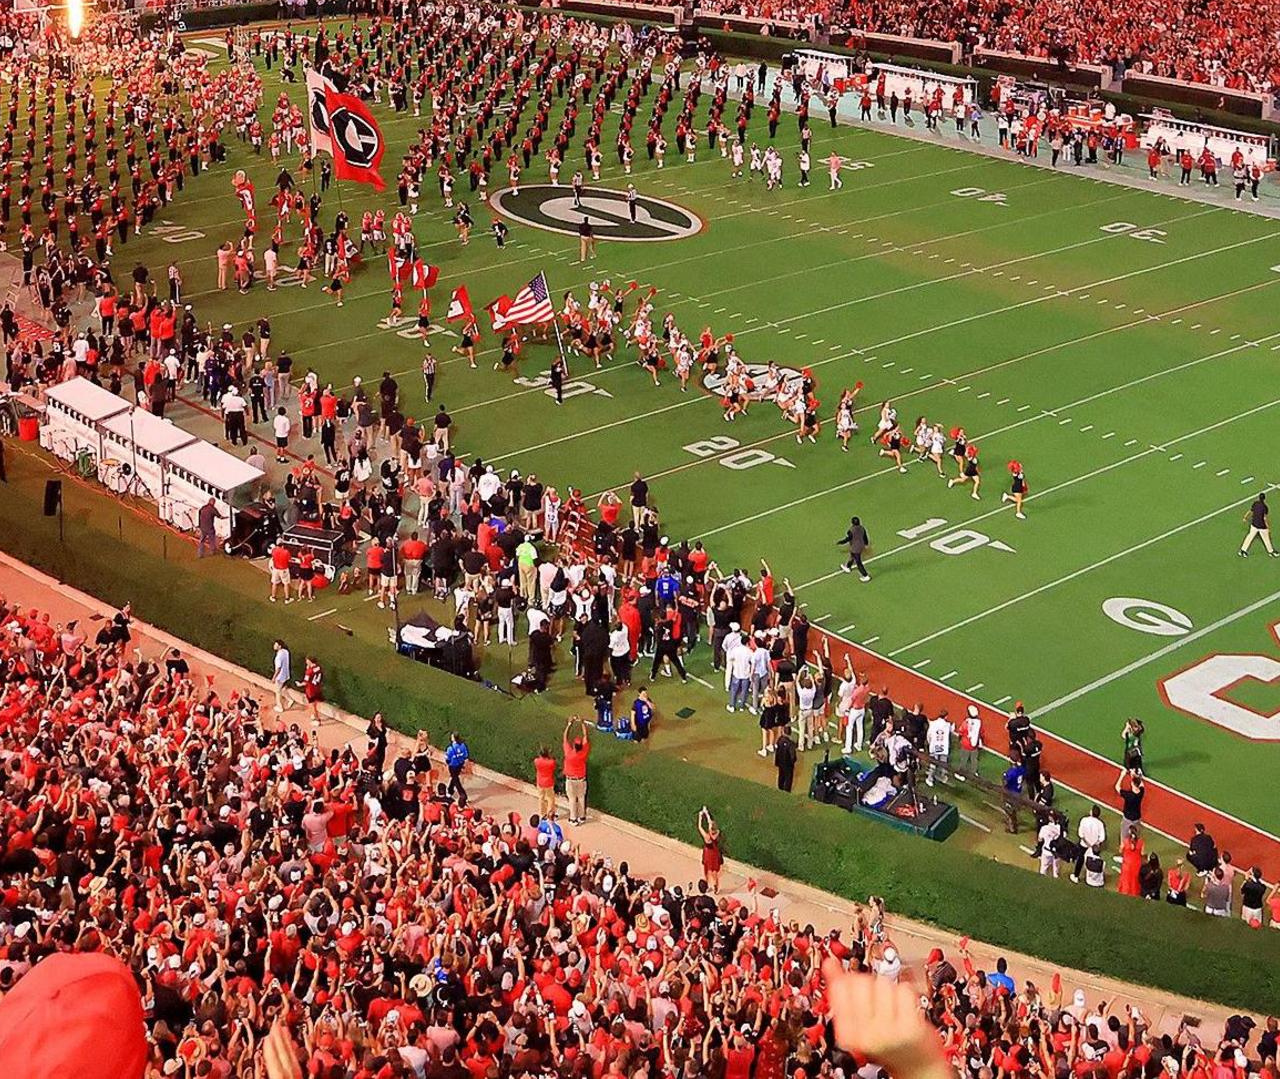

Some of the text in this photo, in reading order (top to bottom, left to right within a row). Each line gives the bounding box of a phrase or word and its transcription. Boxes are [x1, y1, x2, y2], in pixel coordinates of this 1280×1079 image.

[950, 187, 1008, 203] 40
[1100, 221, 1167, 240] 30
[681, 435, 776, 471] 20
[896, 517, 991, 556] 10
[1101, 596, 1195, 637] G
